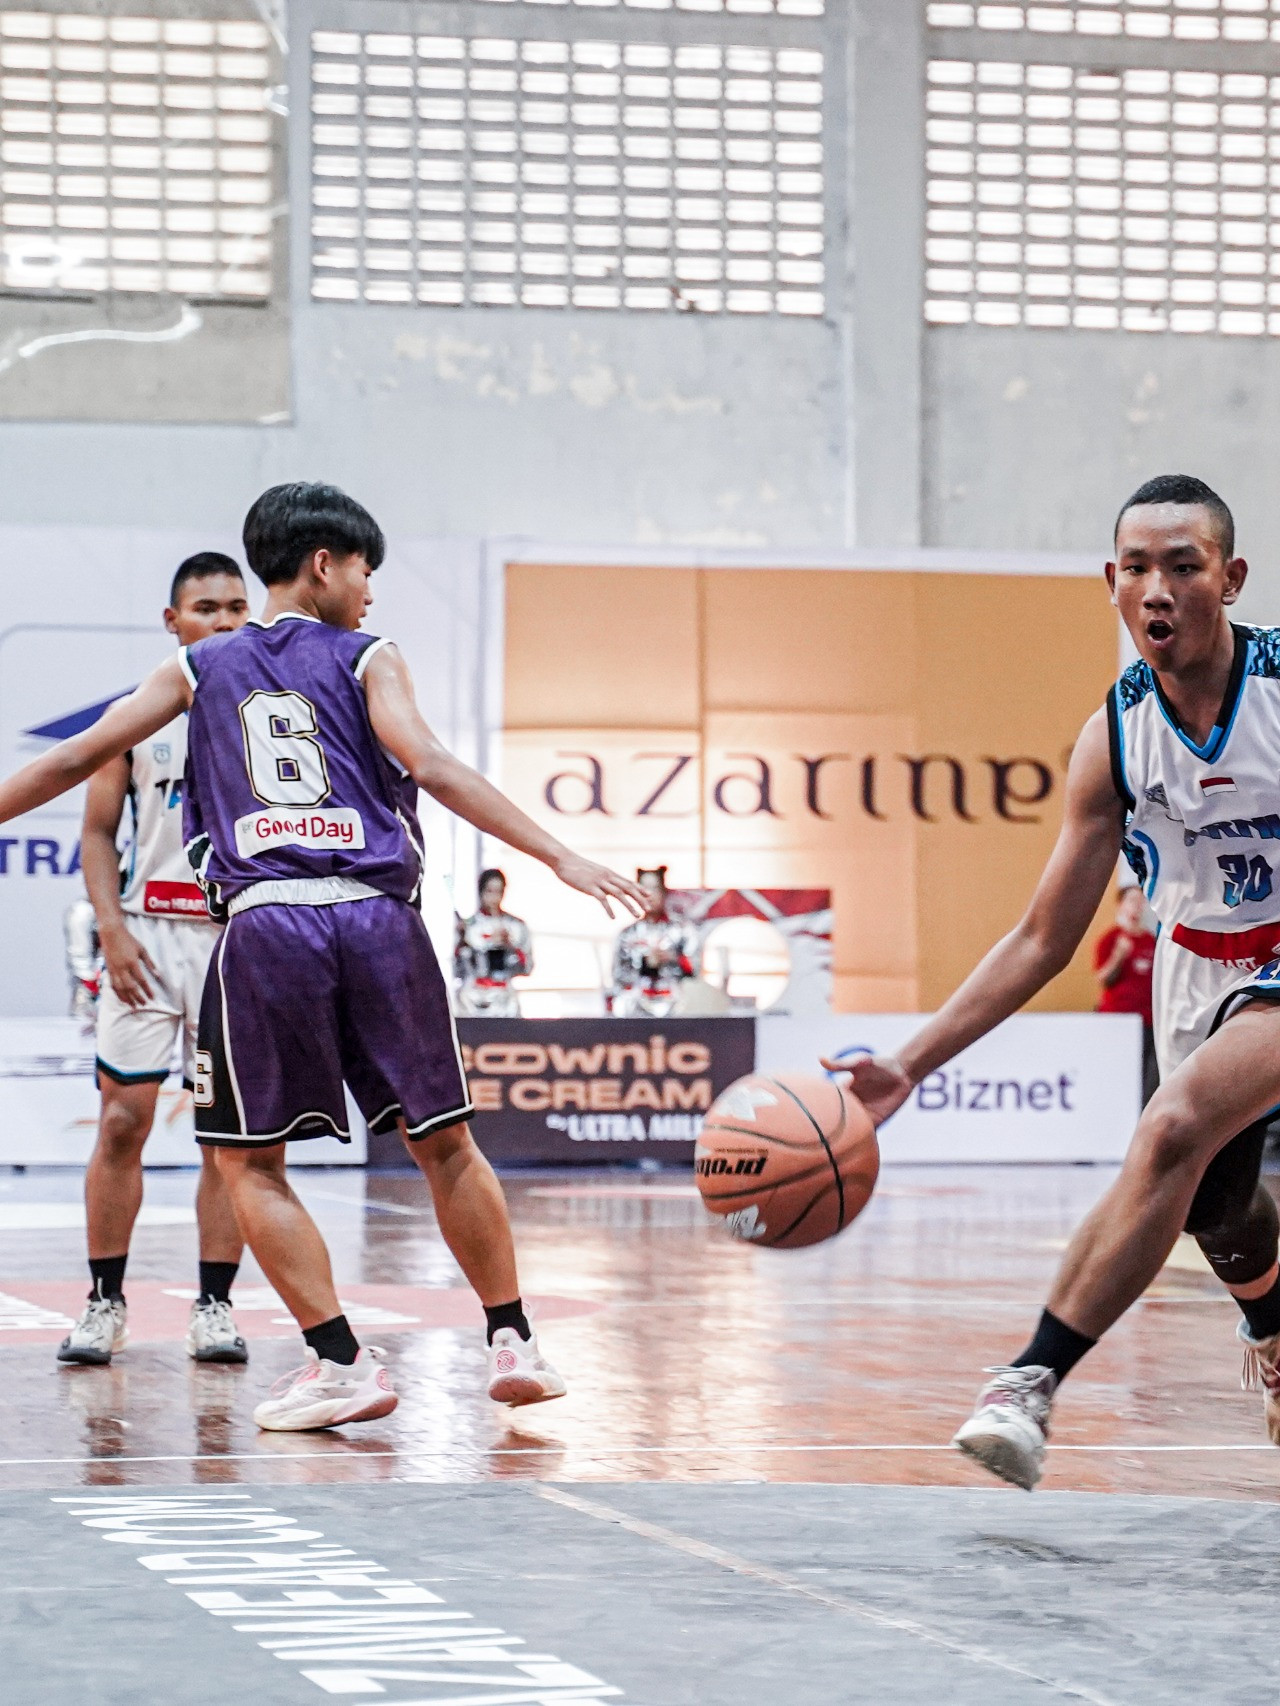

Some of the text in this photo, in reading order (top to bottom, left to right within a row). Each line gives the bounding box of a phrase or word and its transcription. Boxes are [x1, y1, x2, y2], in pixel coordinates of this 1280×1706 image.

[238, 689, 332, 809] 6
[255, 817, 307, 839] Good
[311, 816, 354, 843] Day
[1216, 854, 1274, 909] 30
[509, 1078, 714, 1112] CREAM
[917, 1069, 1074, 1111] Biznet
[567, 1113, 647, 1142] ULTRA
